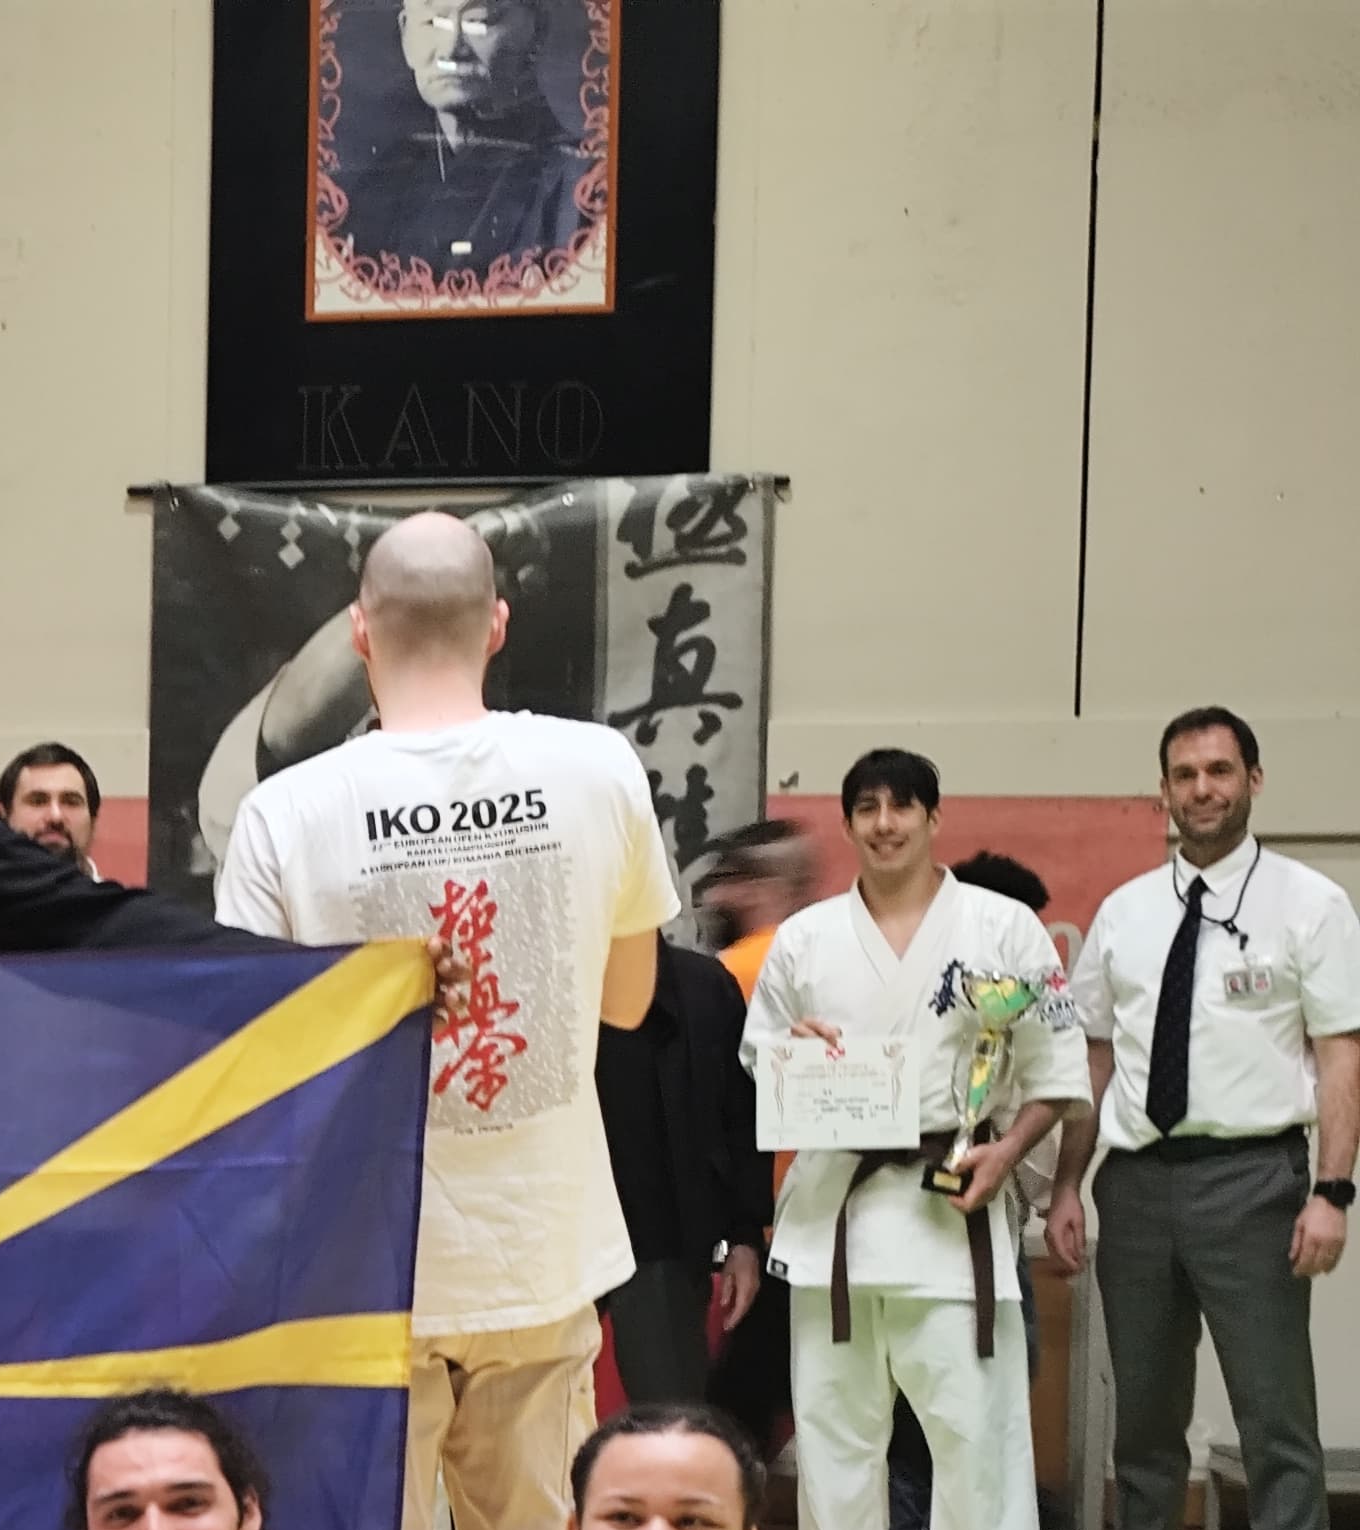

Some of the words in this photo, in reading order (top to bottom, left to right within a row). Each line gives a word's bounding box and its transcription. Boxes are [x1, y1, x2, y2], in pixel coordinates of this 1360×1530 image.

[296, 380, 606, 471] KANO
[366, 803, 441, 842] IKO
[448, 788, 548, 833] 2025
